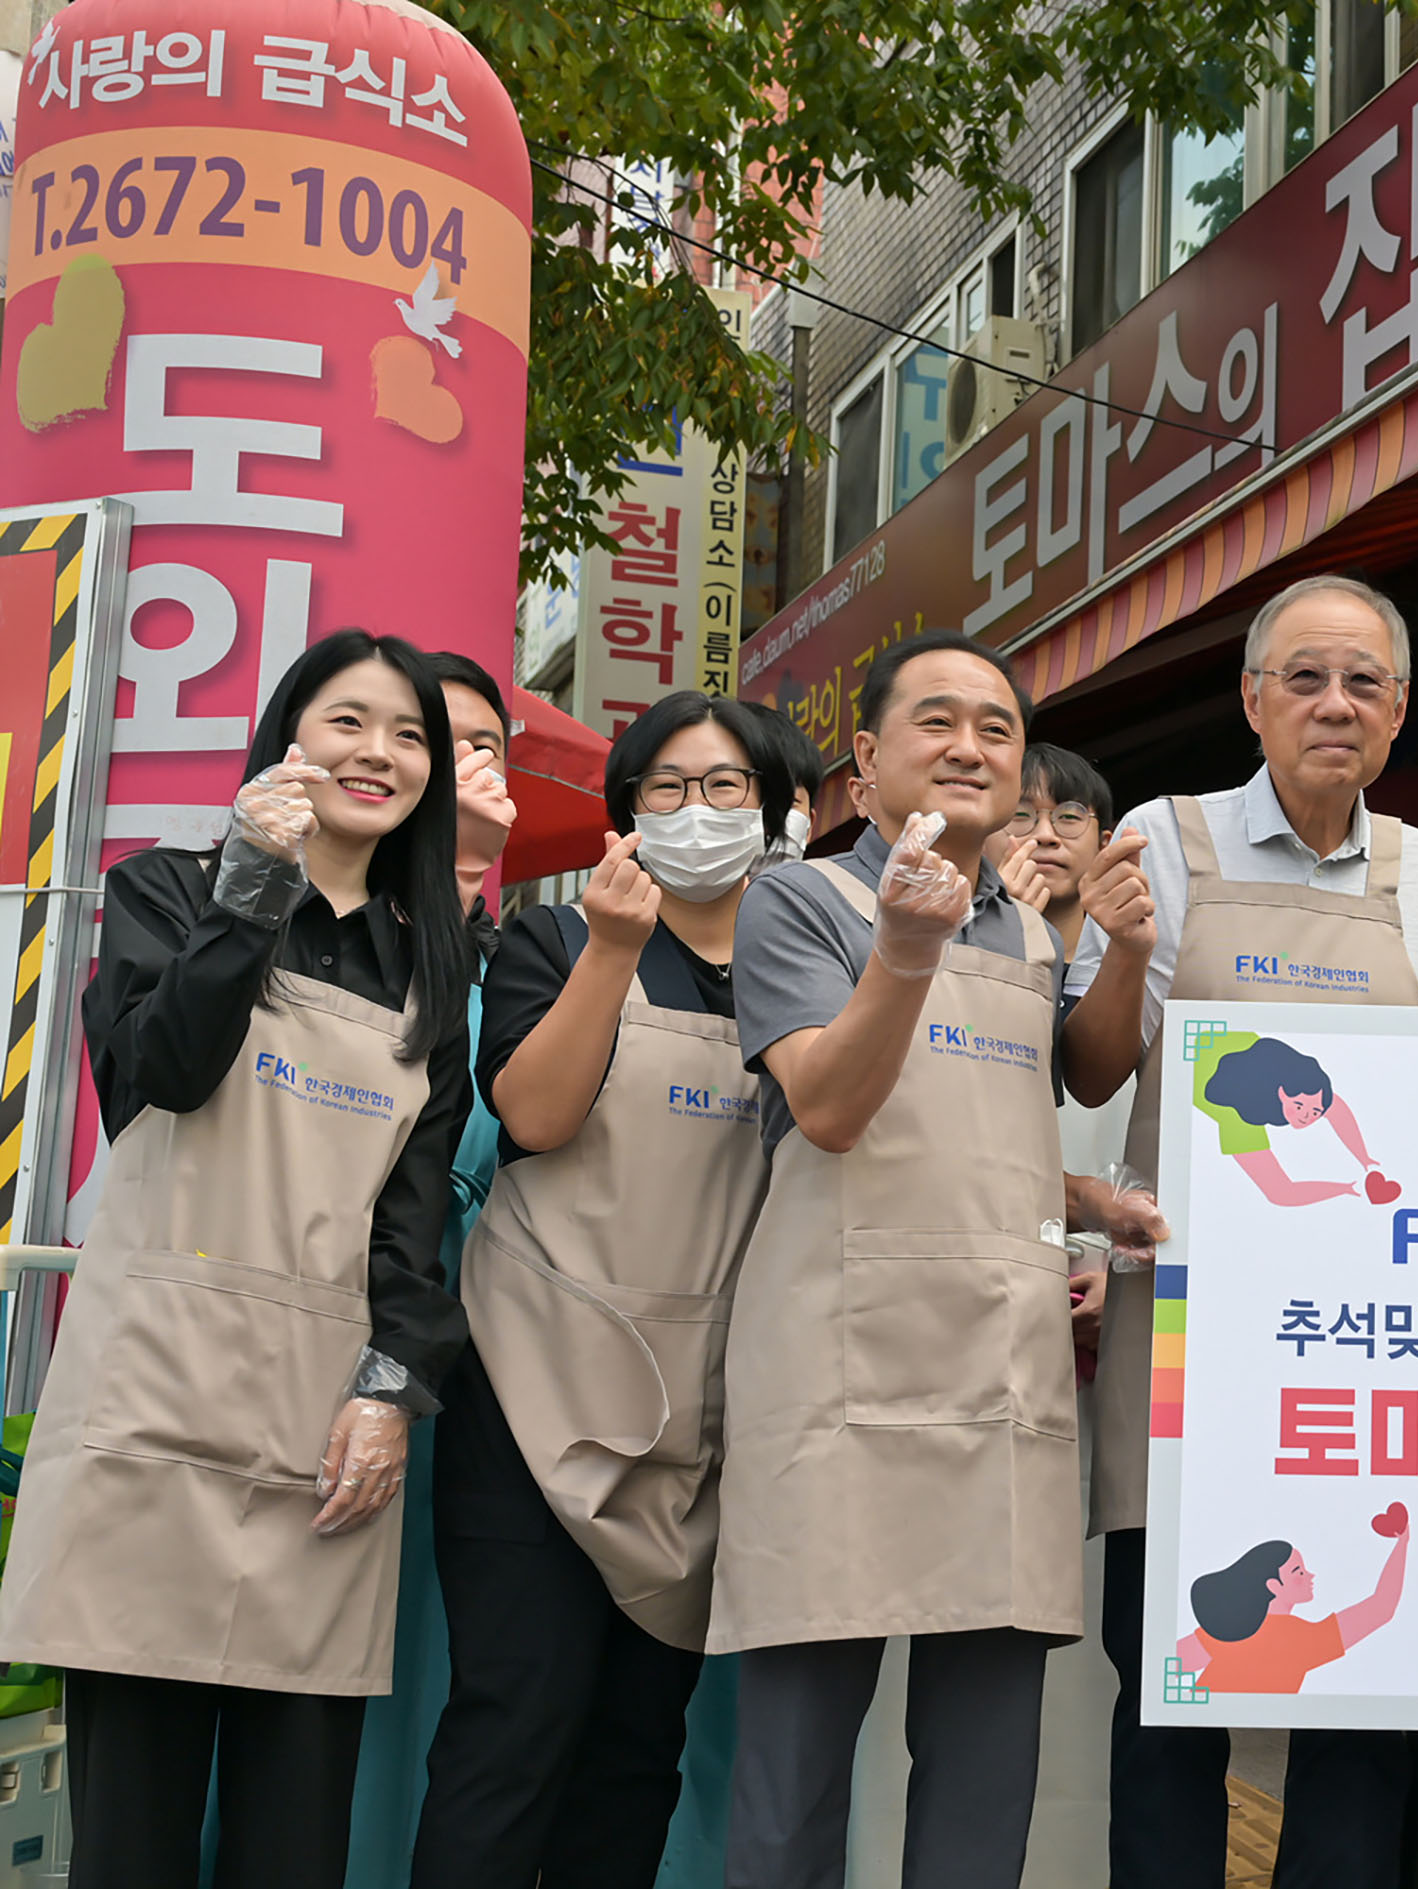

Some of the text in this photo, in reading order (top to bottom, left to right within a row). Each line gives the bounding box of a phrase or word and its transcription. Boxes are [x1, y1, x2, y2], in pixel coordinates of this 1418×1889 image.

[38, 29, 468, 147] 사랑의 급식소
[32, 156, 467, 285] T.2672-1004
[962, 302, 1278, 640] 토마스의
[707, 463, 738, 568] 상담소
[1236, 955, 1279, 974] FKI
[1287, 963, 1369, 983] 한국경제인협회
[1236, 975, 1250, 983] The
[1252, 976, 1293, 986] Federation
[1304, 981, 1330, 990] Korean
[929, 1024, 968, 1047] FKI
[256, 1052, 296, 1085] FKI
[305, 1077, 393, 1111] 한국경제인협회
[669, 1085, 710, 1109] FKI
